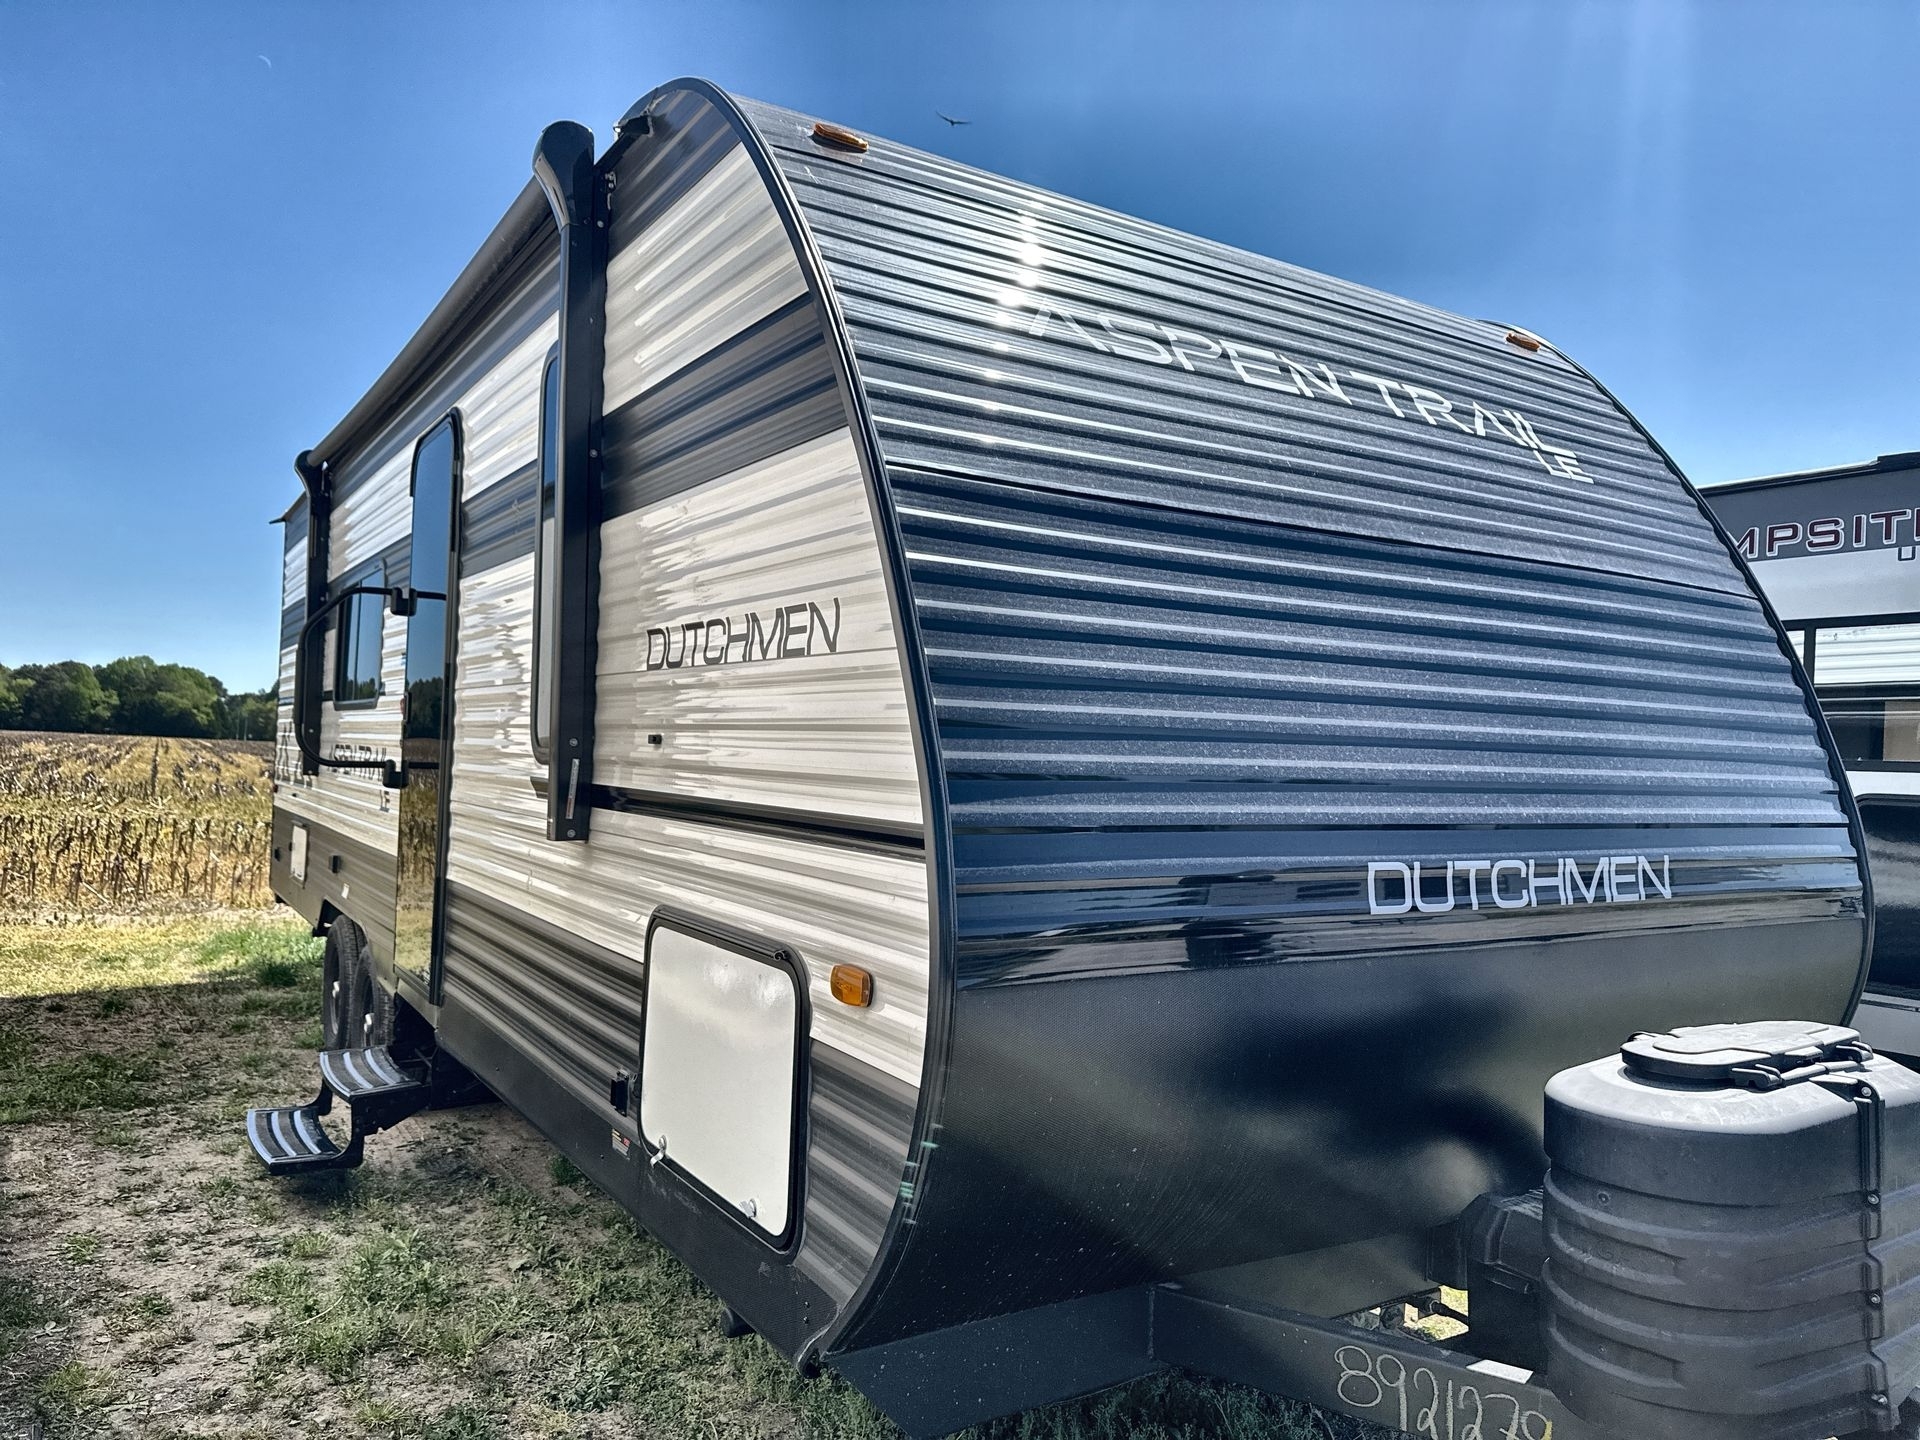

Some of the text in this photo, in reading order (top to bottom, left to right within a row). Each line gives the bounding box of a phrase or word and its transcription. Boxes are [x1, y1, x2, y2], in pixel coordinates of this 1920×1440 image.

[1028, 302, 1577, 458] ASPEN TRAIL
[1533, 450, 1594, 484] LE
[646, 597, 841, 671] DUTCHMEN
[1367, 855, 1672, 915] DUTCHMEN
